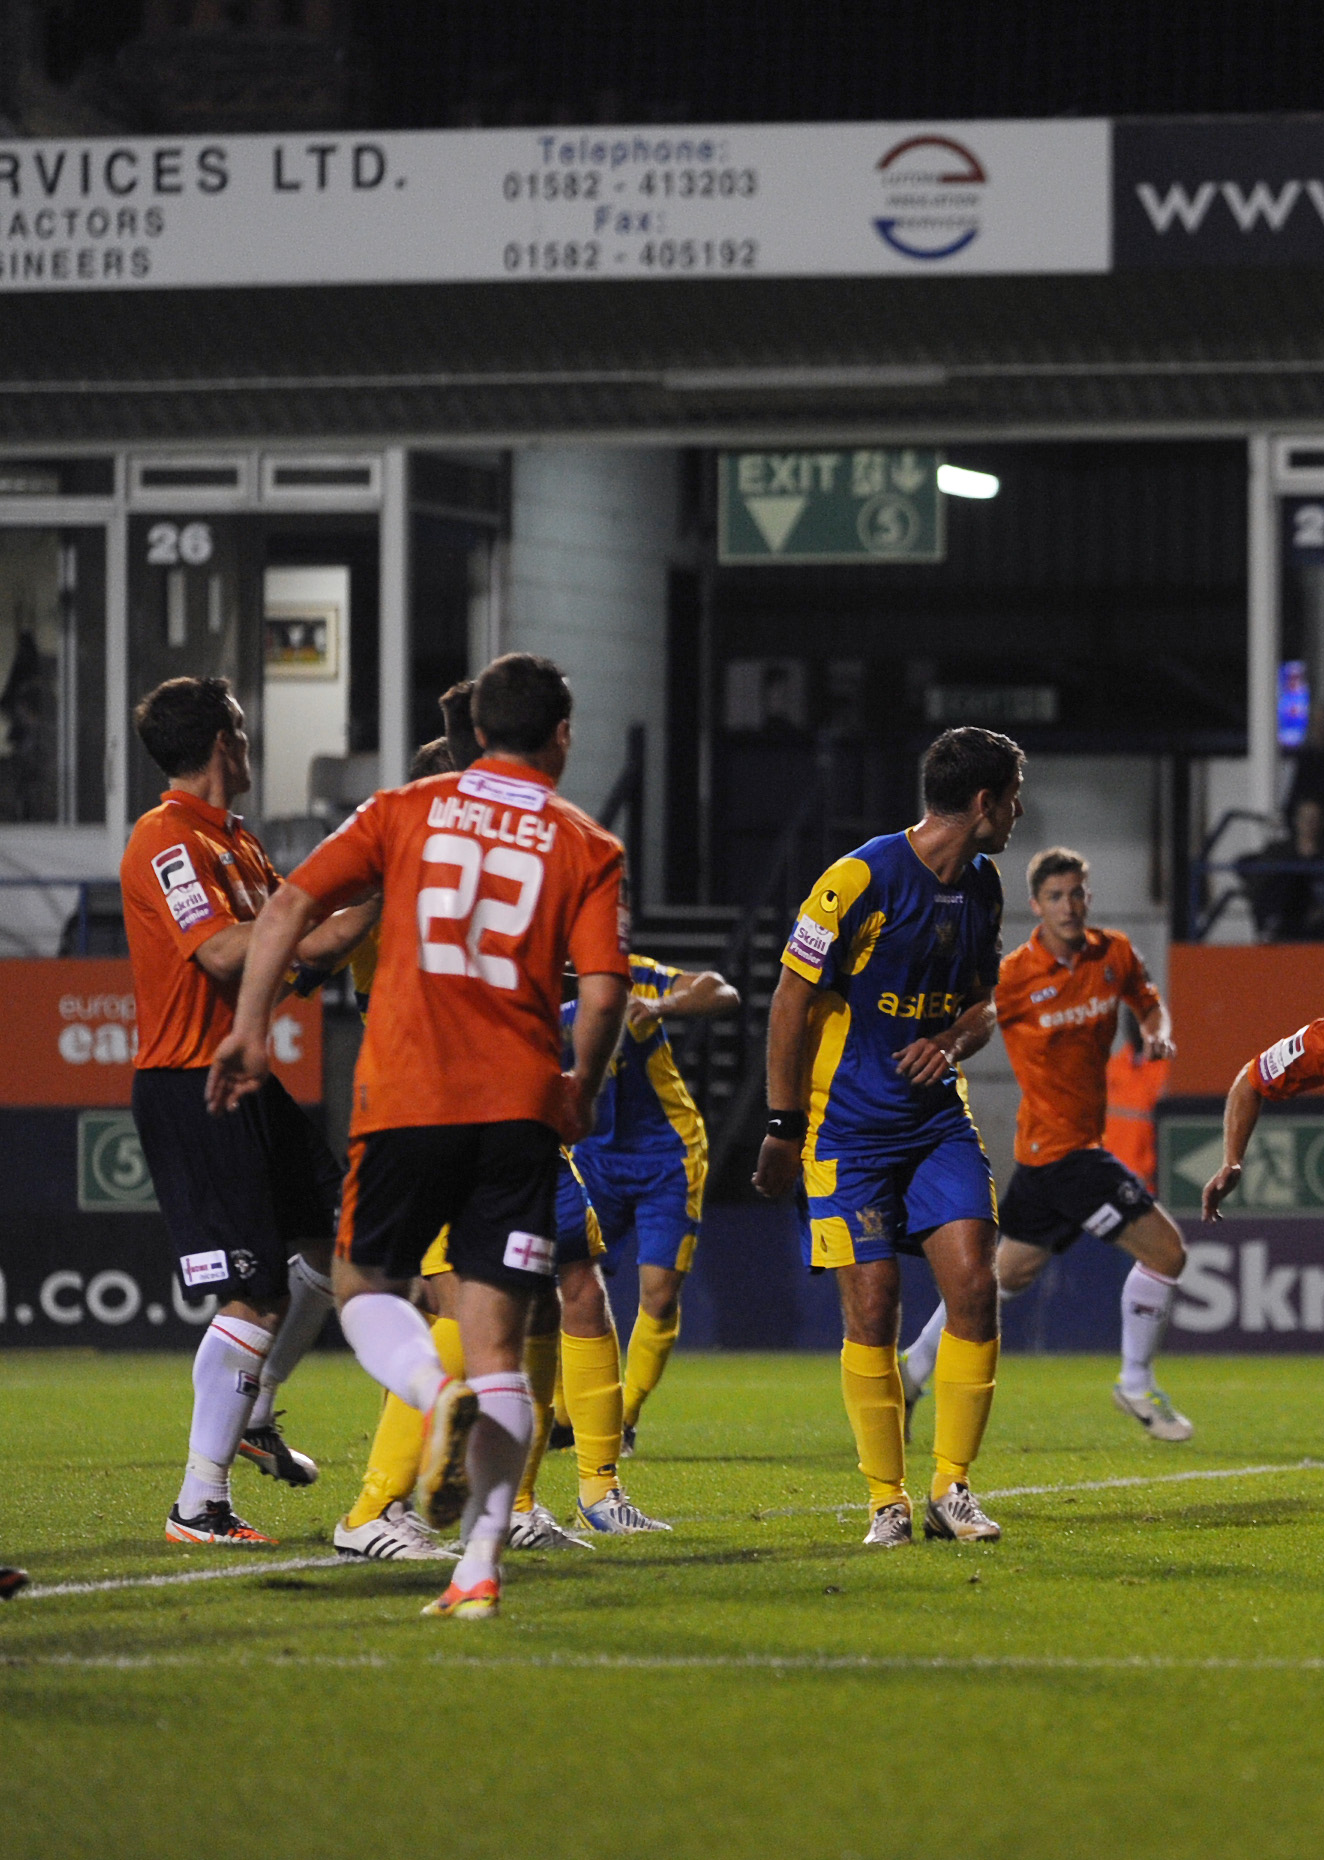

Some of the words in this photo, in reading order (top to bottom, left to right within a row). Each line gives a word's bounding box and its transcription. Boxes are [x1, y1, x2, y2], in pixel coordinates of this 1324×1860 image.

[273, 143, 407, 192] LTD.
[538, 134, 728, 171] Telephone:
[502, 170, 600, 202] 01582
[638, 167, 758, 200] 413203
[8, 206, 165, 241] ACTORS
[0, 247, 151, 280] INEERS
[502, 240, 600, 273] 01582
[638, 238, 758, 271] 405192
[738, 453, 839, 495] EXIT
[146, 521, 213, 566] 26
[427, 796, 557, 853] WHALLEY
[417, 833, 545, 991] 22
[789, 941, 821, 965] Premier
[798, 927, 826, 953] Skrill
